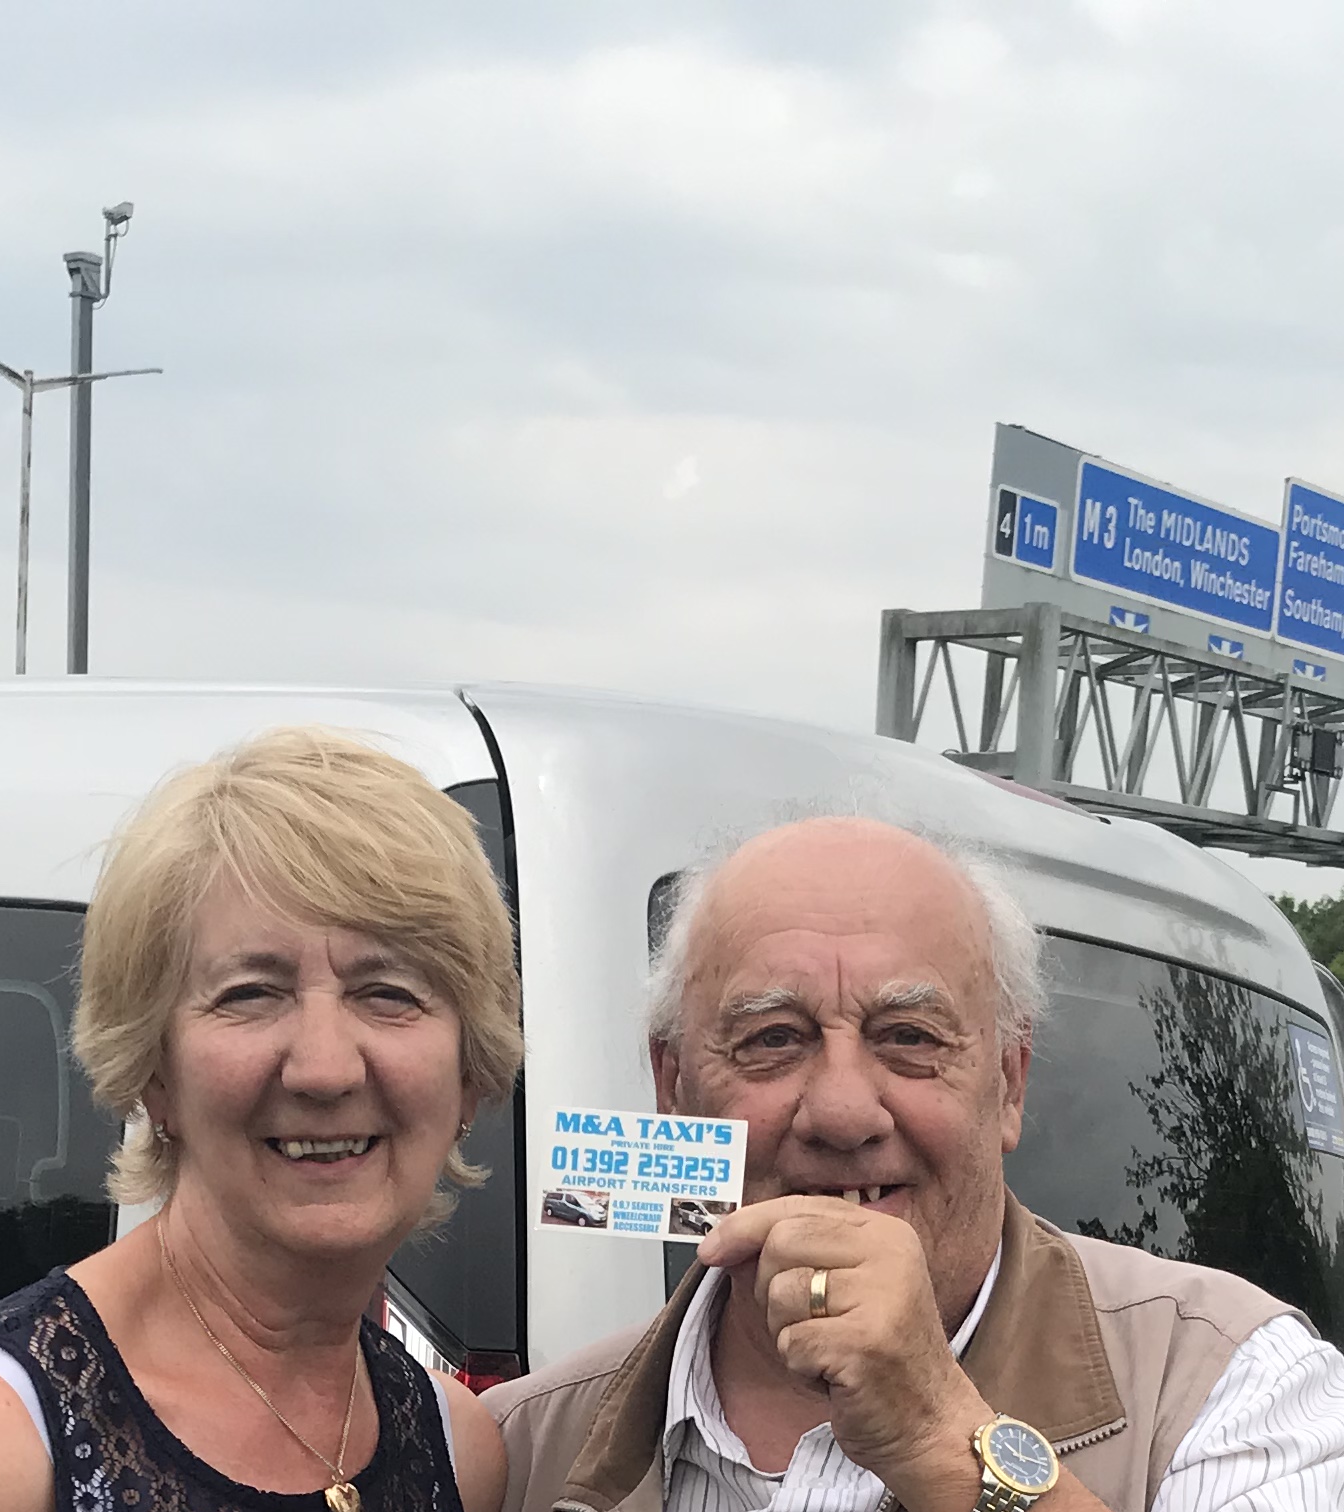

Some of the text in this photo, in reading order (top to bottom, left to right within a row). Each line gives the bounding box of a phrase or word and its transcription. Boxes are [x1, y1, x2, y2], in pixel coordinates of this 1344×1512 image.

[999, 511, 1012, 539] 4
[1128, 496, 1251, 567] The MIDLANDS
[1123, 542, 1271, 612] London, Winchester
[555, 1111, 732, 1145] M&A TAXI'S
[610, 1139, 676, 1152] PRIVATE HIRE
[551, 1145, 731, 1183] 01392 253253
[561, 1174, 718, 1197] AIRPORT TRANSFERS
